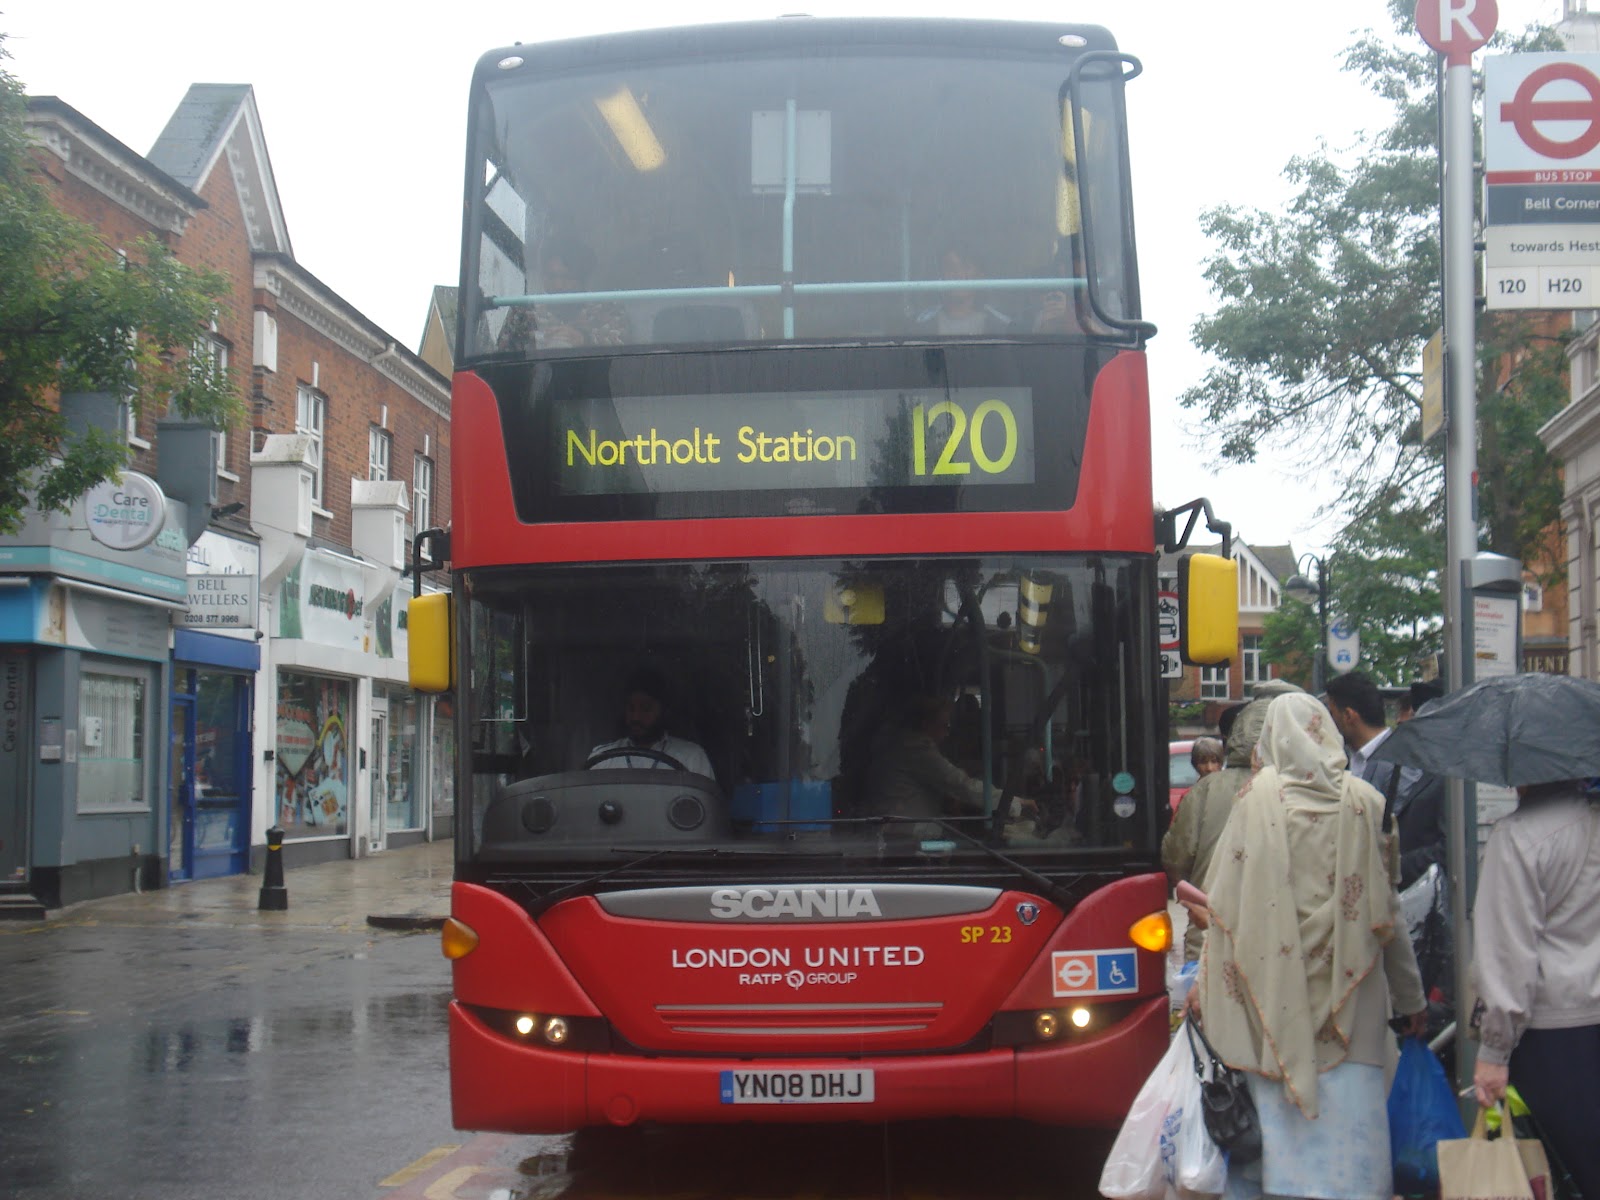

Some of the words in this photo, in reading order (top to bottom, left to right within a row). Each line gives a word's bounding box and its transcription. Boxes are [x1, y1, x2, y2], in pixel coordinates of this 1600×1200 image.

[1439, 0, 1484, 41] R
[1535, 171, 1558, 181] BUS
[1562, 171, 1593, 181] STOP
[1525, 198, 1551, 210] Bell
[1510, 240, 1565, 252] towards
[1499, 280, 1526, 293] 120
[1548, 279, 1582, 292] H20
[567, 427, 721, 466] Northolt
[737, 425, 856, 463] Station
[912, 399, 1018, 475] 120
[112, 492, 149, 507] Care
[96, 504, 152, 521] Dental
[197, 579, 227, 591] BELL
[186, 593, 248, 606] WELLERS
[3, 661, 17, 710] Dental
[3, 717, 16, 753] Care
[710, 888, 882, 919] SCANIA
[961, 927, 984, 944] SP
[990, 926, 1012, 943] 23
[672, 948, 790, 969] LONDON
[805, 945, 925, 968] UNITED
[739, 973, 783, 986] RATP
[806, 972, 858, 985] GROUP
[735, 1073, 804, 1098] YN08
[811, 1073, 863, 1098] DHJ
